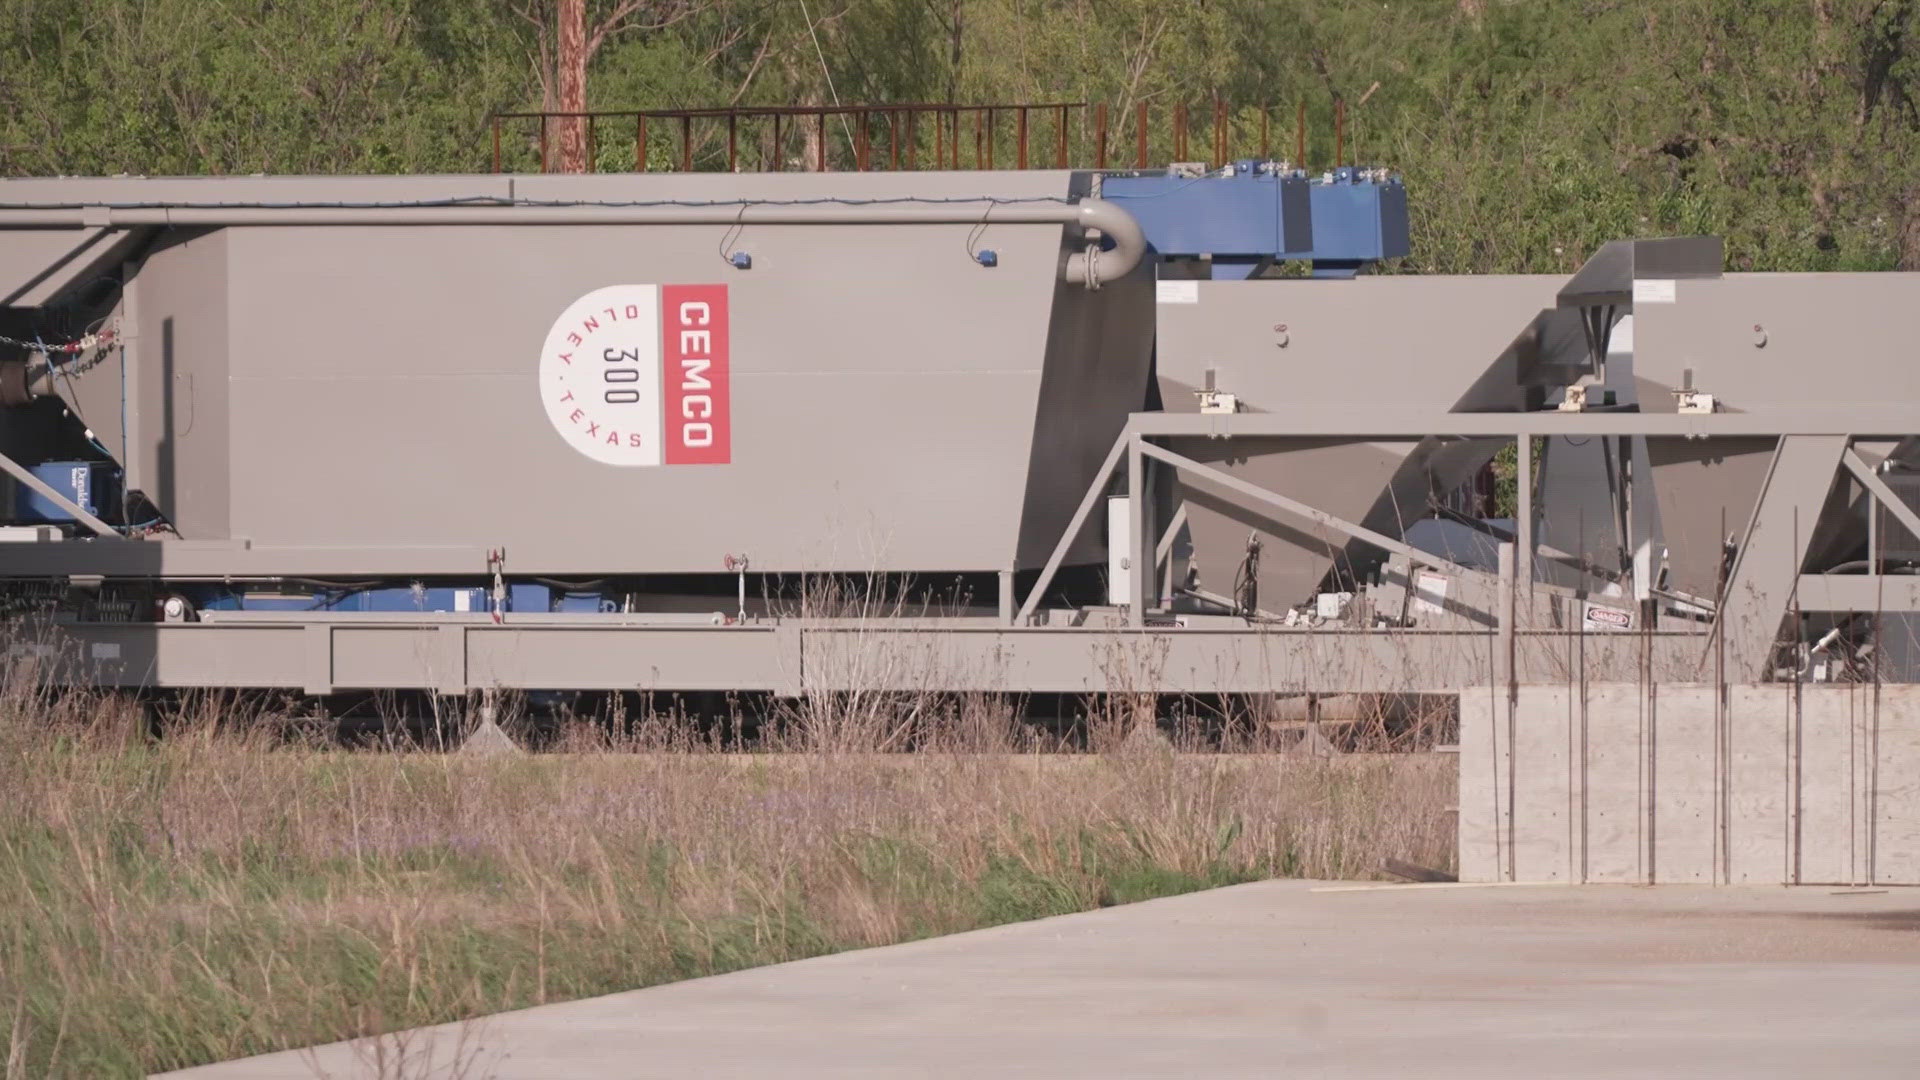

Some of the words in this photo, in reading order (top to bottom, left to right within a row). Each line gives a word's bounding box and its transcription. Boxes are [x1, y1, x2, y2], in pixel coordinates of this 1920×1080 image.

[559, 304, 638, 365] OLNEY
[603, 348, 640, 404] 300
[680, 302, 713, 447] CEMCO
[560, 390, 641, 447] TEXAS
